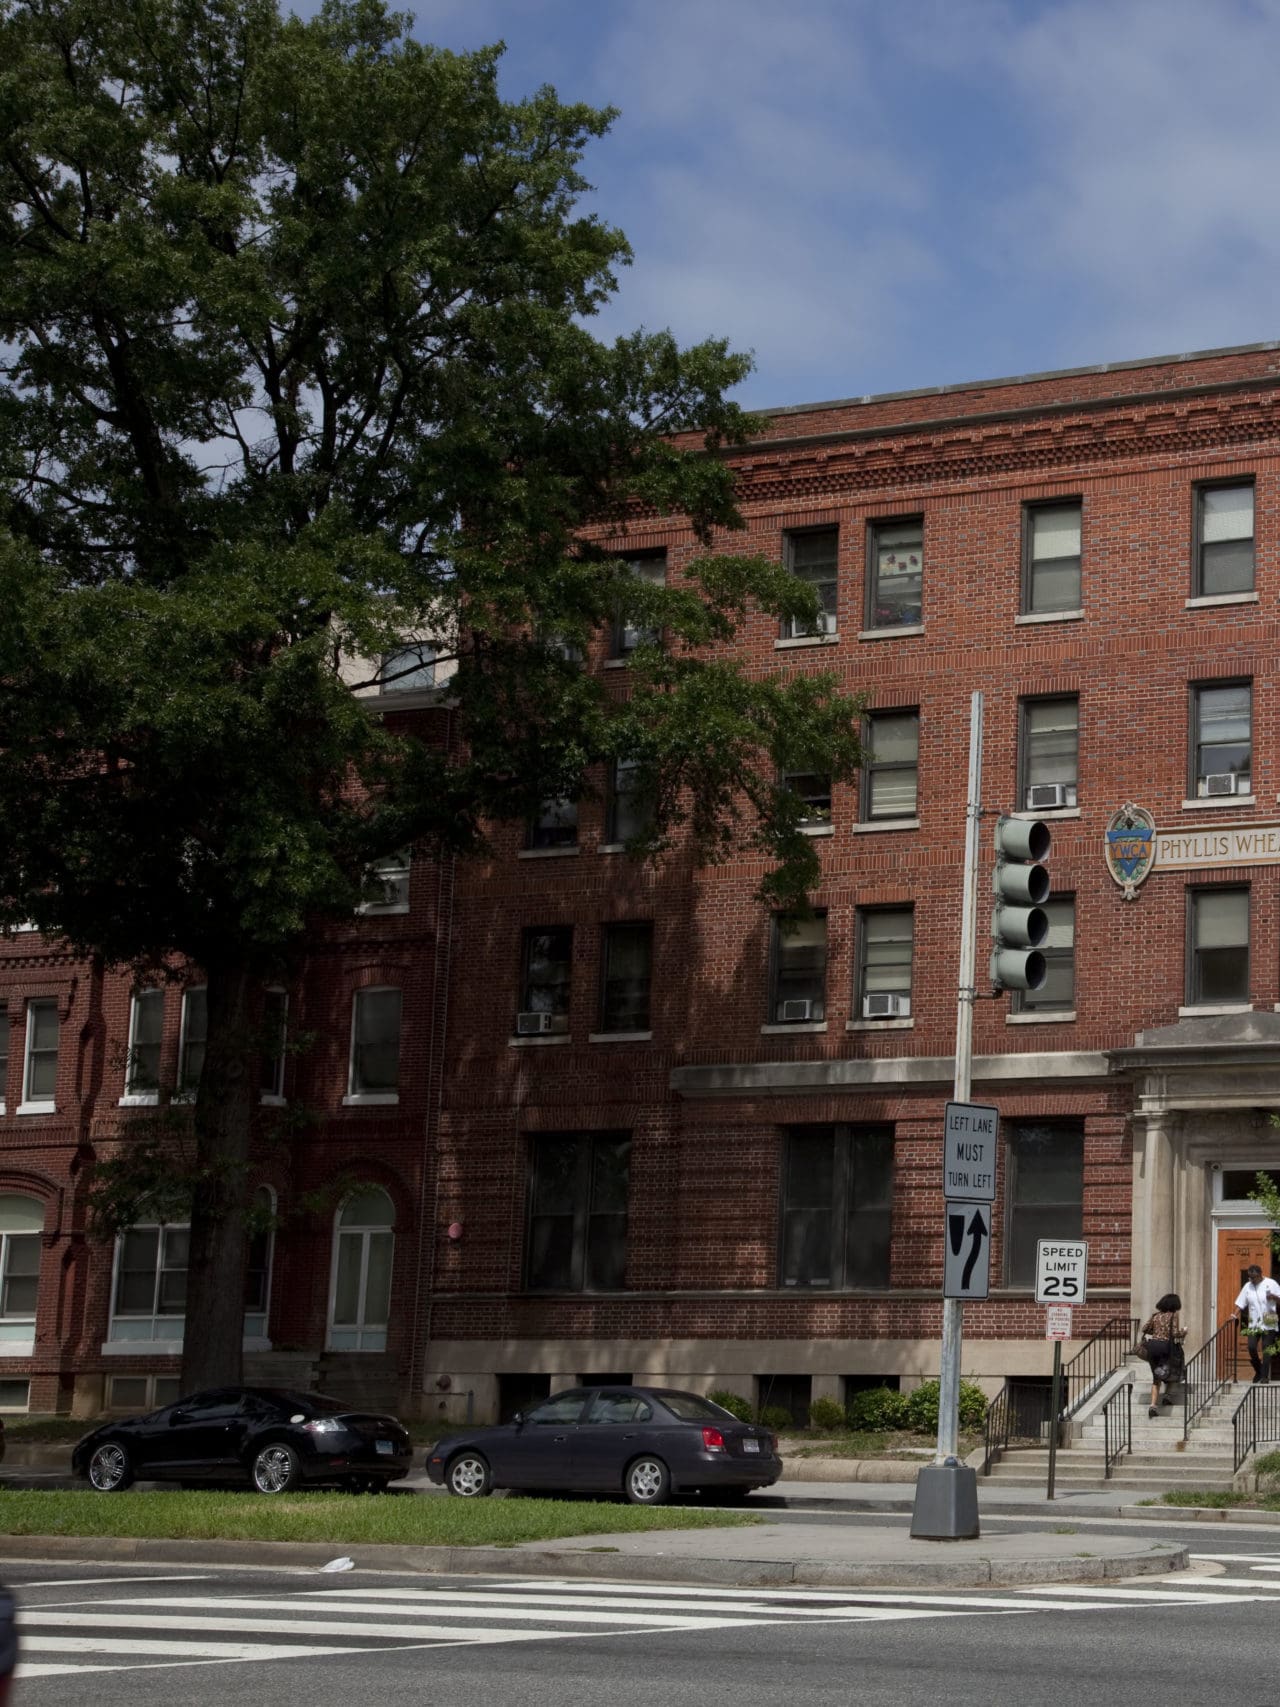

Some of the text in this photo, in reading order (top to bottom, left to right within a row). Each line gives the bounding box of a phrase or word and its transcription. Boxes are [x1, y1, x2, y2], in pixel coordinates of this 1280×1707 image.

[1110, 844, 1148, 858] YWCA
[1161, 837, 1229, 859] PHYLLIS
[950, 1116, 993, 1134] LEFT LANE
[956, 1143, 985, 1162] MUST
[948, 1172, 992, 1189] TURN LEFT
[1042, 1247, 1083, 1258] SPEED
[1046, 1262, 1078, 1272] LIMIT
[1043, 1276, 1079, 1297] 25
